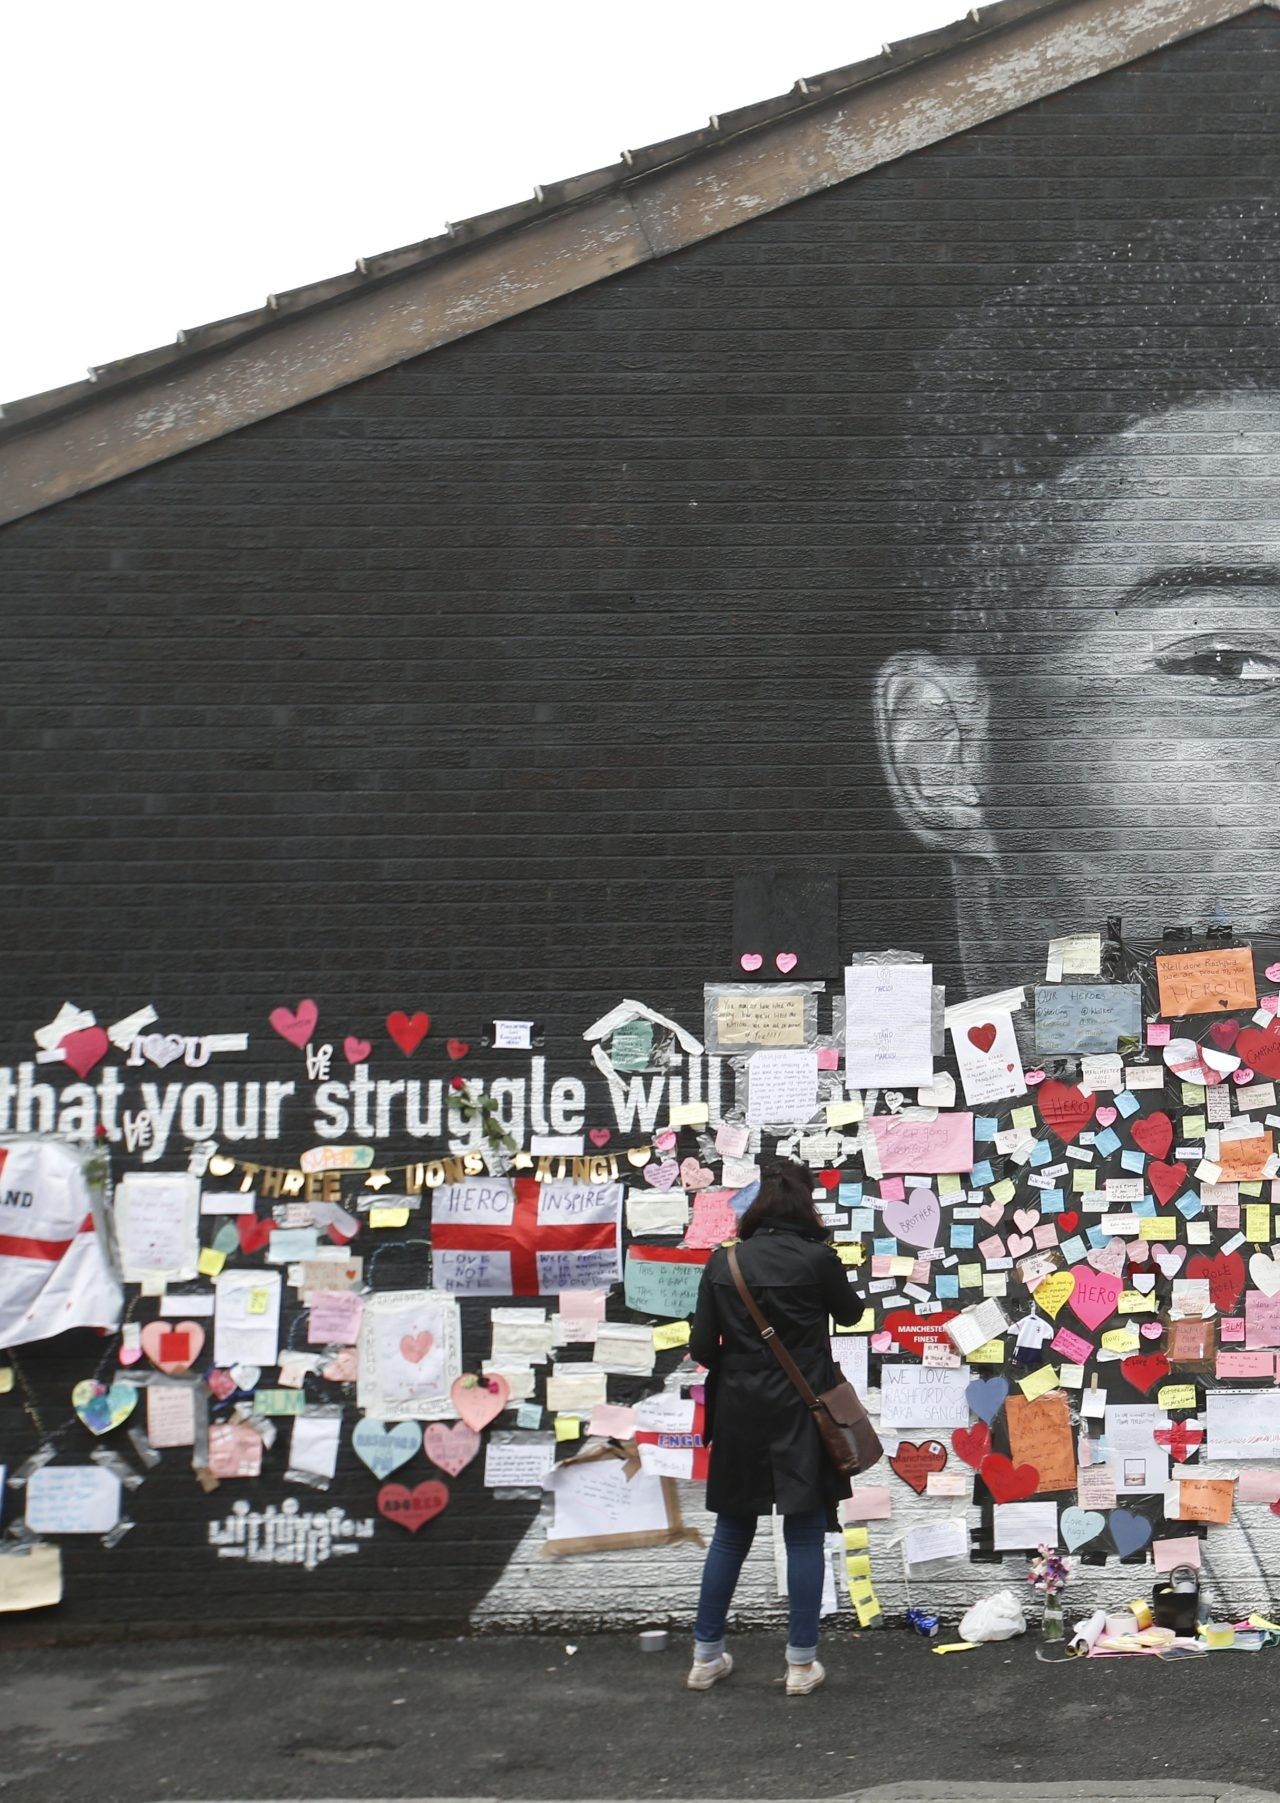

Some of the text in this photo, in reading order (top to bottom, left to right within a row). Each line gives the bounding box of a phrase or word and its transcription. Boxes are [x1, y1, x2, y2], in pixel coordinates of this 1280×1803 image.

[1160, 961, 1179, 972] Well
[1071, 991, 1106, 1001] HEROES
[0, 1061, 124, 1142] that
[140, 1081, 295, 1163] your
[313, 1056, 585, 1156] struggle
[606, 1051, 724, 1134] will
[1051, 1097, 1090, 1122] HERO
[241, 1161, 342, 1202] THREE
[405, 1152, 484, 1195] LIONS
[0, 1190, 33, 1208] ND
[448, 1187, 510, 1213] HERO
[541, 1190, 607, 1213] INSPIRE
[900, 1204, 936, 1234] BROTHER
[442, 1254, 491, 1265] LOVE
[456, 1266, 488, 1280] NOT
[1077, 1282, 1117, 1305] HERO
[913, 1335, 938, 1343] FINEST
[887, 1369, 951, 1385] WE LOVE
[885, 1386, 943, 1404] RASHFORD
[924, 1404, 969, 1421] SANCHO
